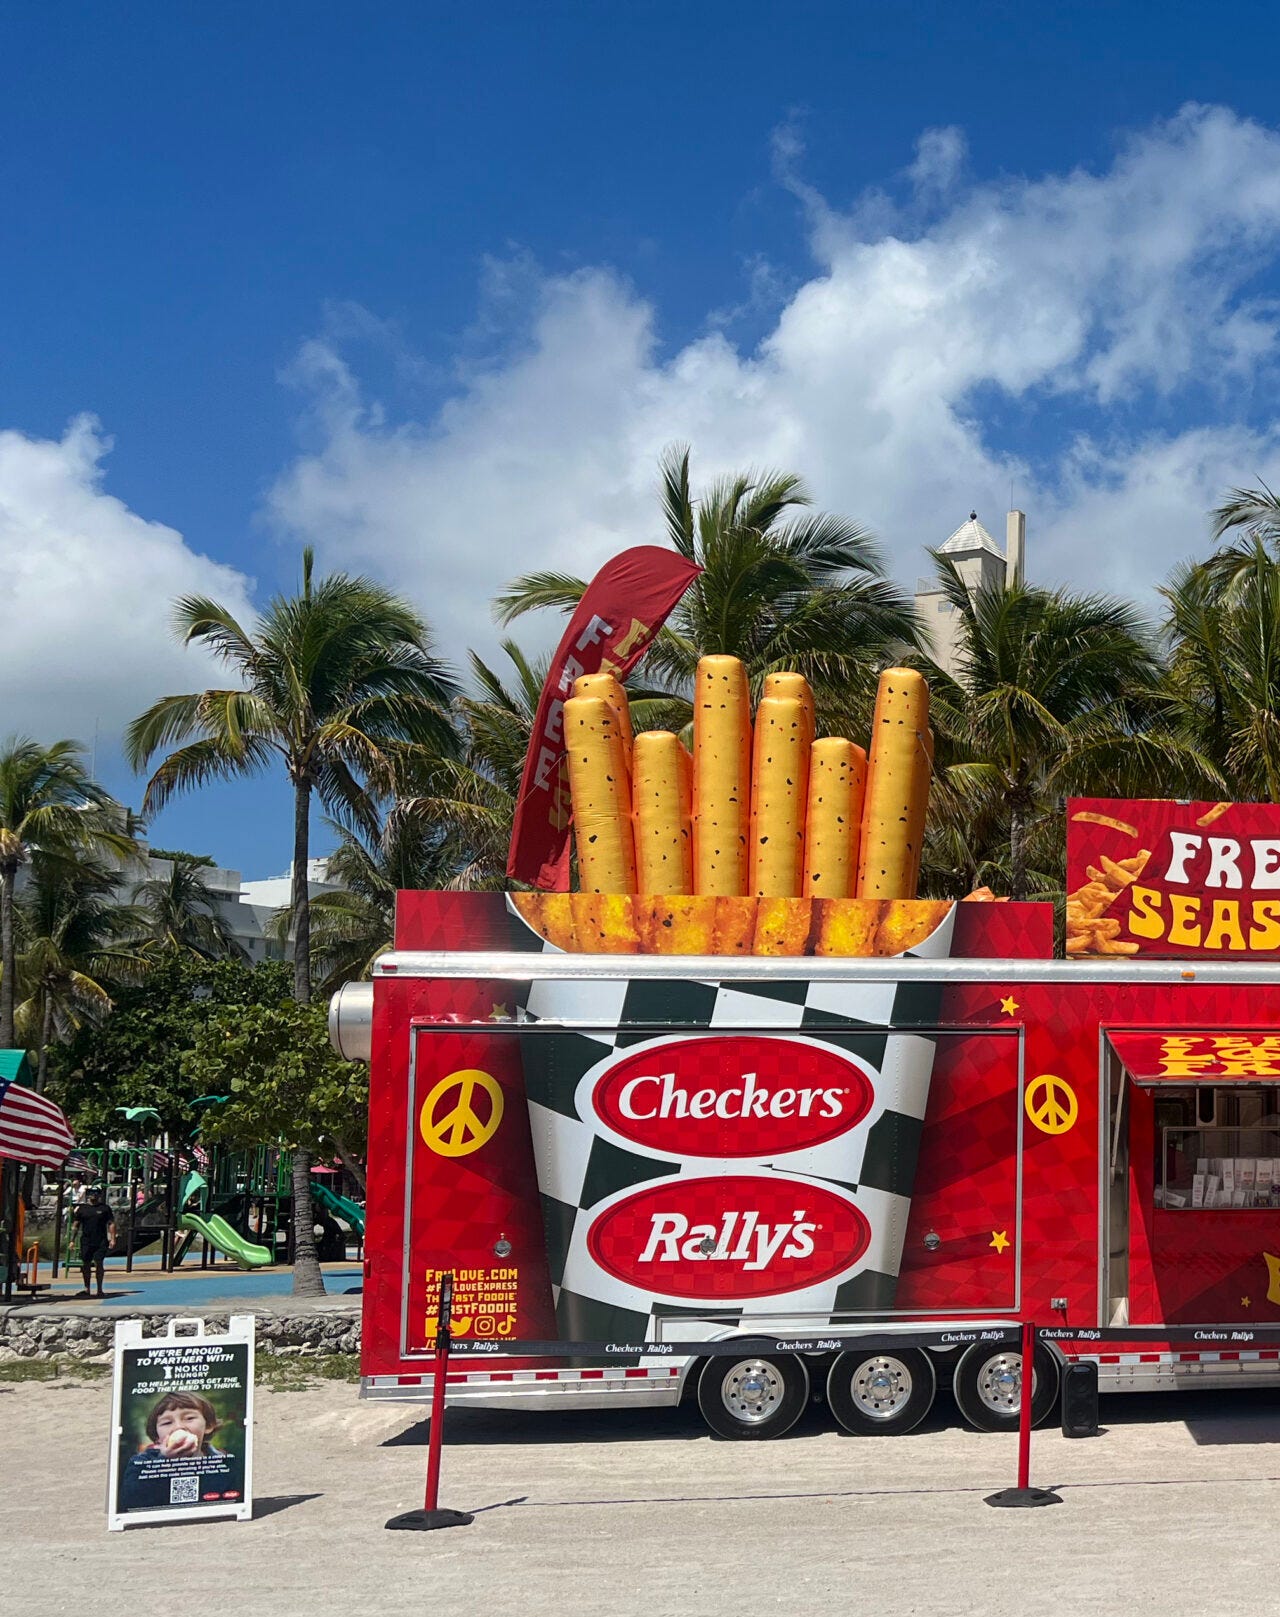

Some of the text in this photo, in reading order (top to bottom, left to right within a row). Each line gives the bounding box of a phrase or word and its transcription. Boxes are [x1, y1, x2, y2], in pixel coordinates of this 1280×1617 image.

[534, 614, 613, 791] FREE
[618, 1072, 843, 1120] Checkers
[638, 1210, 815, 1270] Rally's
[426, 1282, 518, 1292] #FLOVEEXPRESS
[426, 1294, 440, 1303] TH
[941, 1331, 1004, 1342] Checkers Rally's
[1040, 1329, 1100, 1340] Checkers Rally's
[1194, 1331, 1254, 1341] Checkers Rally's
[472, 1342, 499, 1352] Rally's
[605, 1344, 672, 1354] Checkers Rally's
[776, 1340, 842, 1350] Checkers Rally's
[148, 1347, 223, 1358] WE'RE PROUD
[137, 1354, 234, 1366] TO PARTNER WITH
